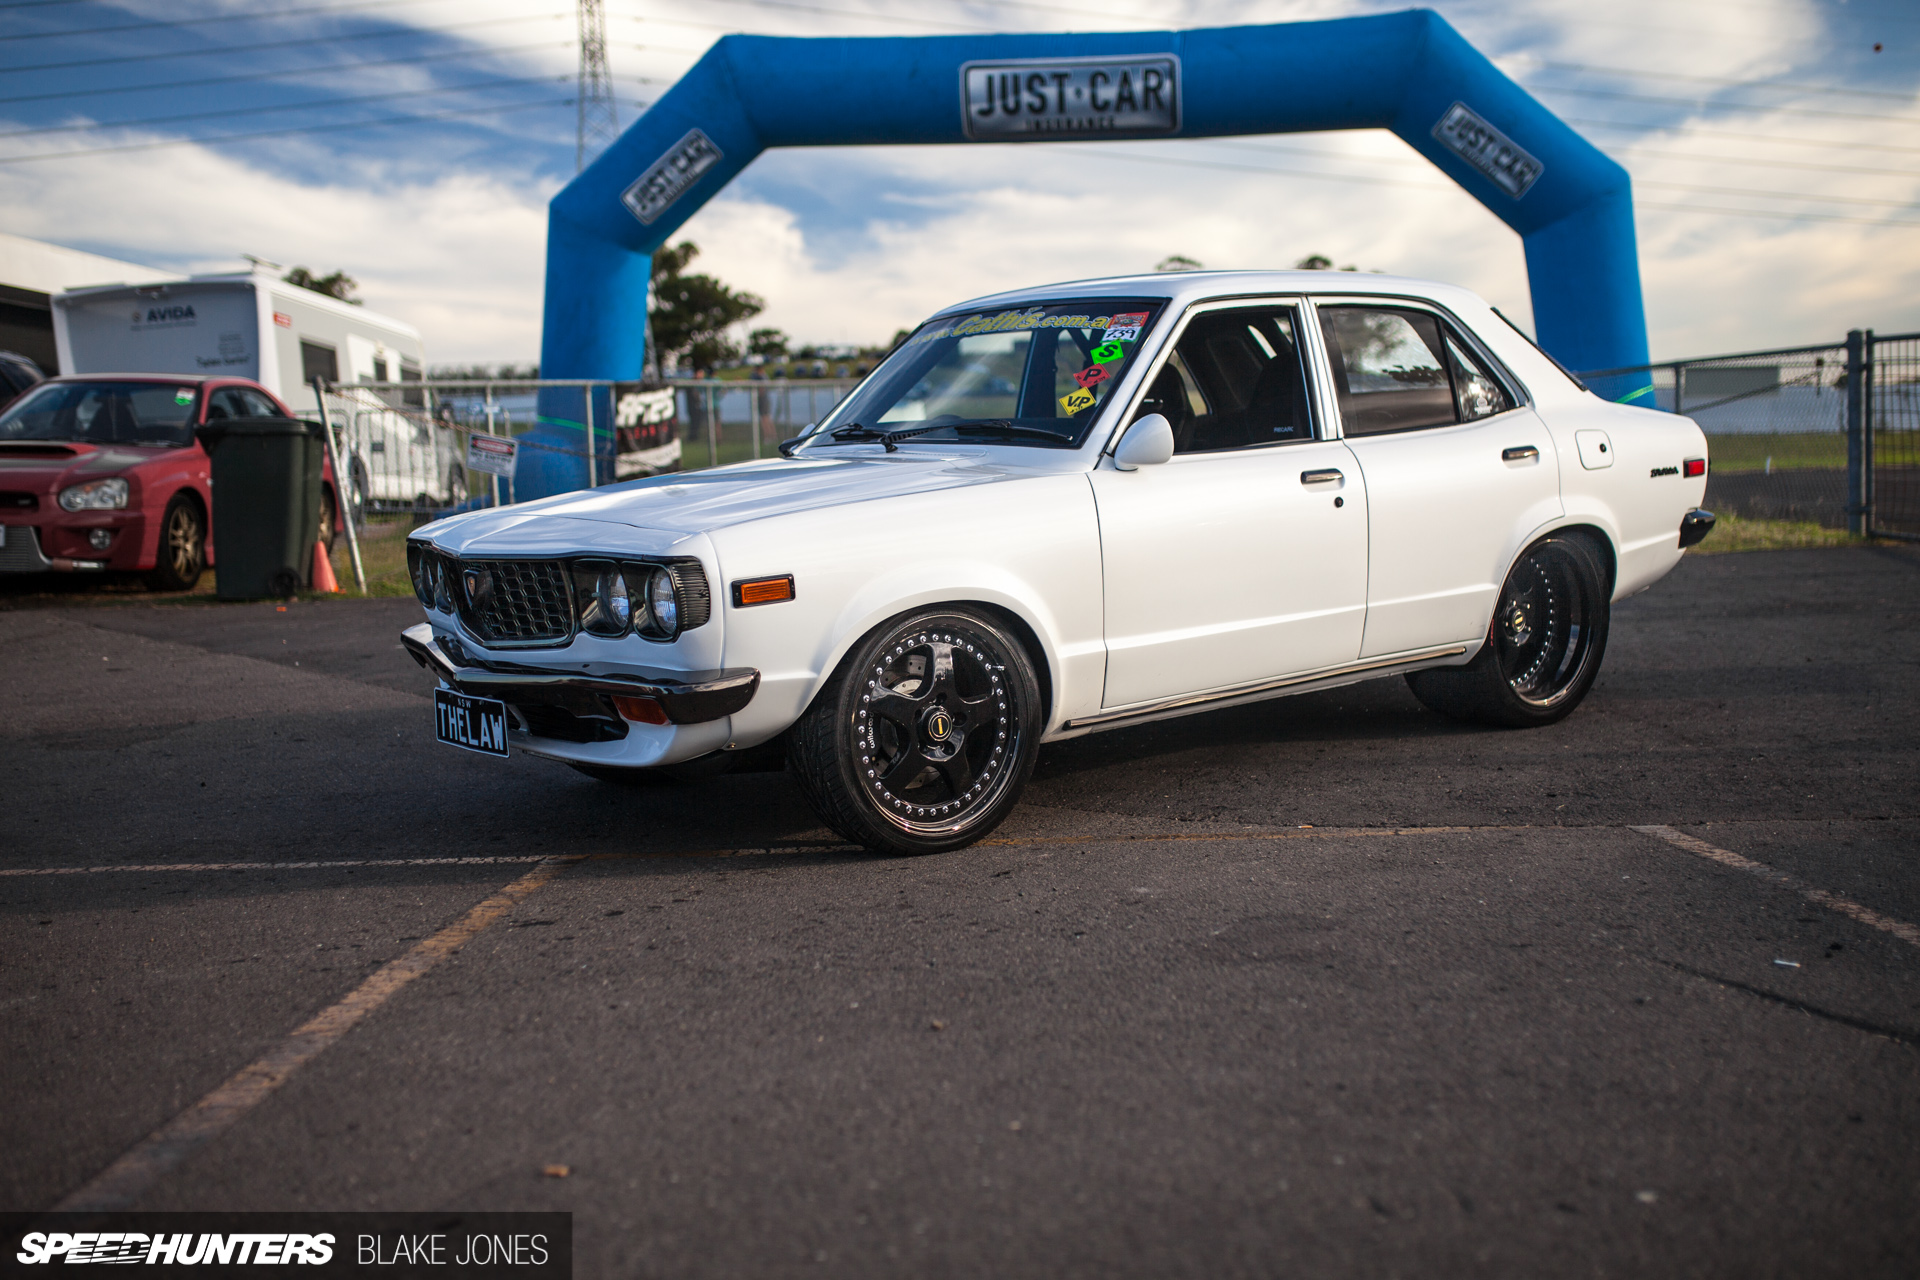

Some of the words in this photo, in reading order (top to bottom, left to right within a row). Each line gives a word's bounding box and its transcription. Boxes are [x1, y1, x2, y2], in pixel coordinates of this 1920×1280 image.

[978, 72, 1070, 116] JUST
[1090, 67, 1166, 112] CAR
[1447, 114, 1496, 154] JUST
[633, 169, 673, 211] JUST
[147, 305, 195, 322] AVIDA
[1098, 344, 1119, 358] S
[1083, 368, 1102, 381] P
[458, 698, 471, 708] NSW
[438, 702, 503, 750] THELAW
